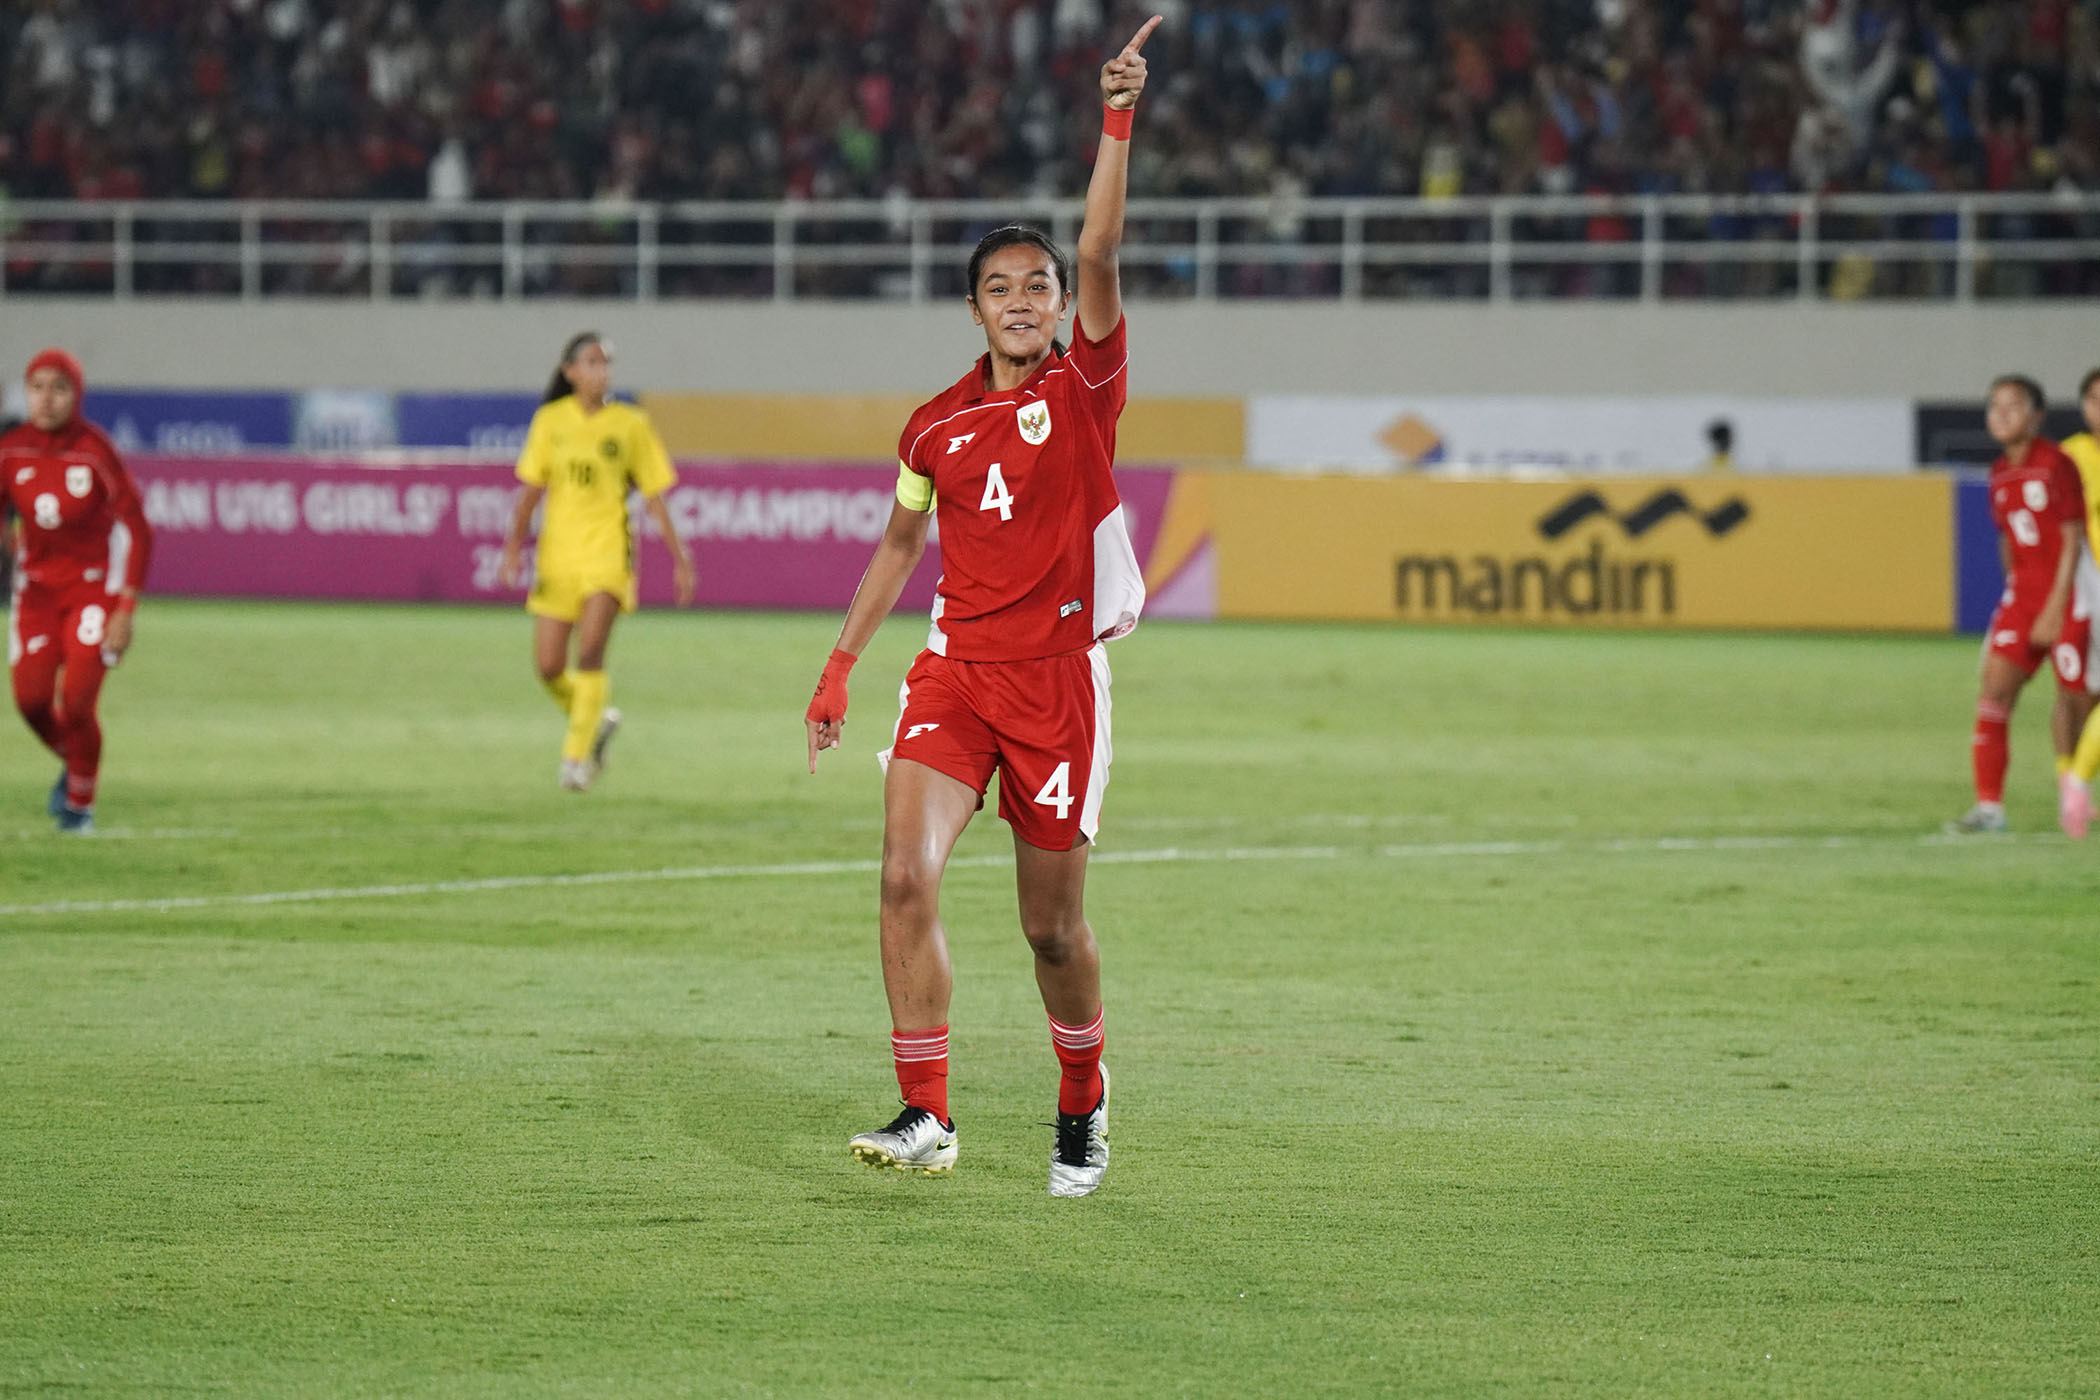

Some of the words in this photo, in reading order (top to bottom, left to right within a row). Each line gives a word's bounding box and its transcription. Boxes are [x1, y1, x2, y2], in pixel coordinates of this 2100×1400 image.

[143, 479, 210, 531] AN
[214, 479, 298, 534] U16
[979, 462, 1014, 521] 4
[1396, 537, 1678, 616] mandiri
[77, 604, 105, 646] 8
[1033, 761, 1075, 820] 4
